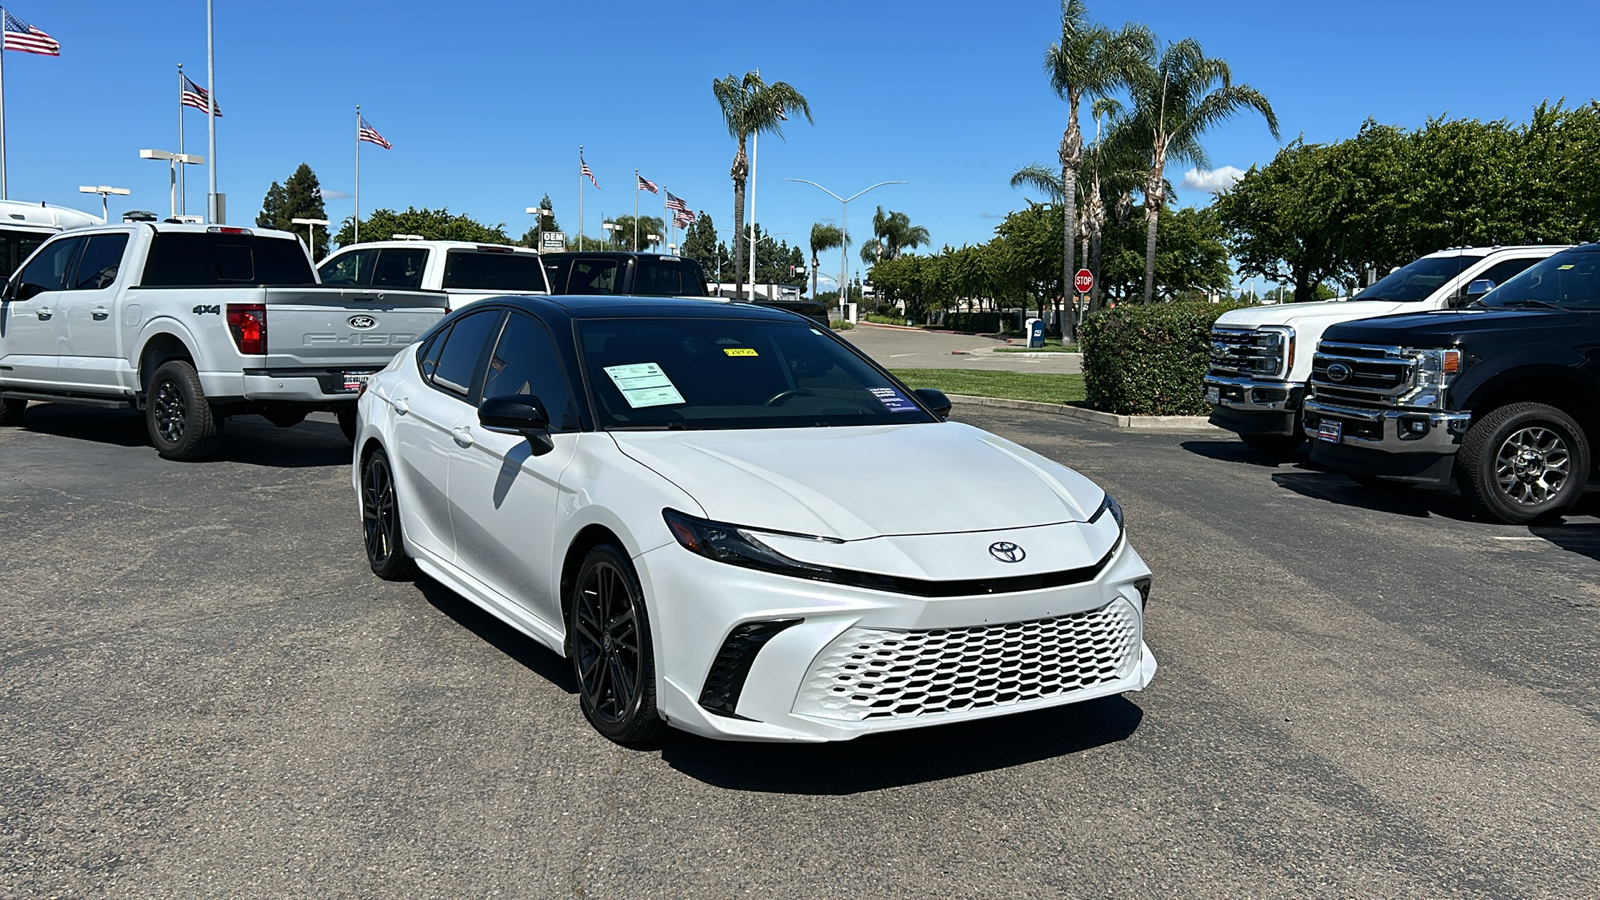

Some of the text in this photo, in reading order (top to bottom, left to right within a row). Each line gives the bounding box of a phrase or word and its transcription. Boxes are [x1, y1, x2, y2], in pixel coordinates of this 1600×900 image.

[543, 233, 564, 241] OEM
[1076, 276, 1092, 285] STOP
[353, 317, 373, 327] Ford
[303, 333, 418, 347] F-150
